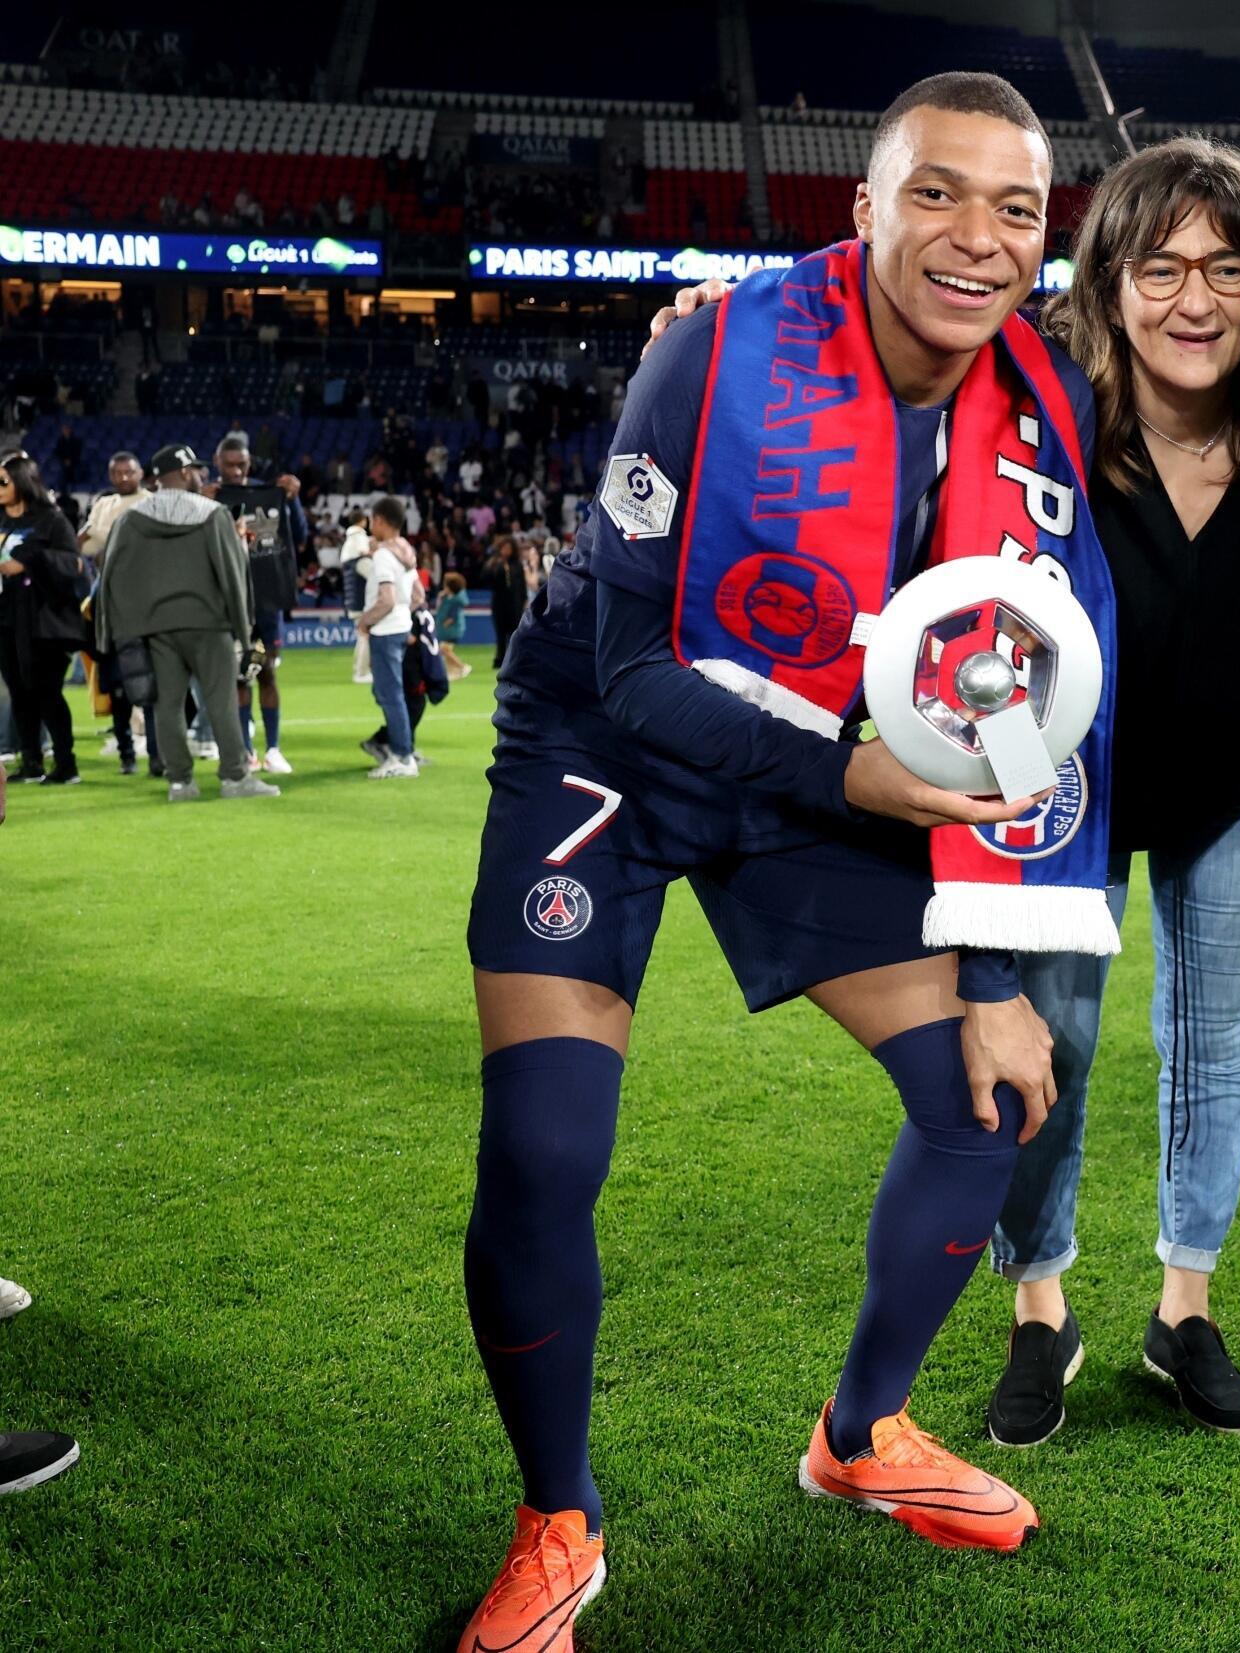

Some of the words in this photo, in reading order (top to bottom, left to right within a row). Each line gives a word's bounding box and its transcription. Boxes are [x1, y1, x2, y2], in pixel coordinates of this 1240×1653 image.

[80, 28, 180, 55] QATR
[486, 248, 569, 277] PARIS
[493, 360, 567, 382] QATAR
[634, 512, 653, 529] Eats
[287, 628, 311, 643] sit
[313, 628, 357, 645] QATA
[1054, 761, 1080, 814] NDICAP
[543, 774, 623, 867] 7
[1054, 815, 1074, 836] PSG
[536, 880, 582, 897] PARIS
